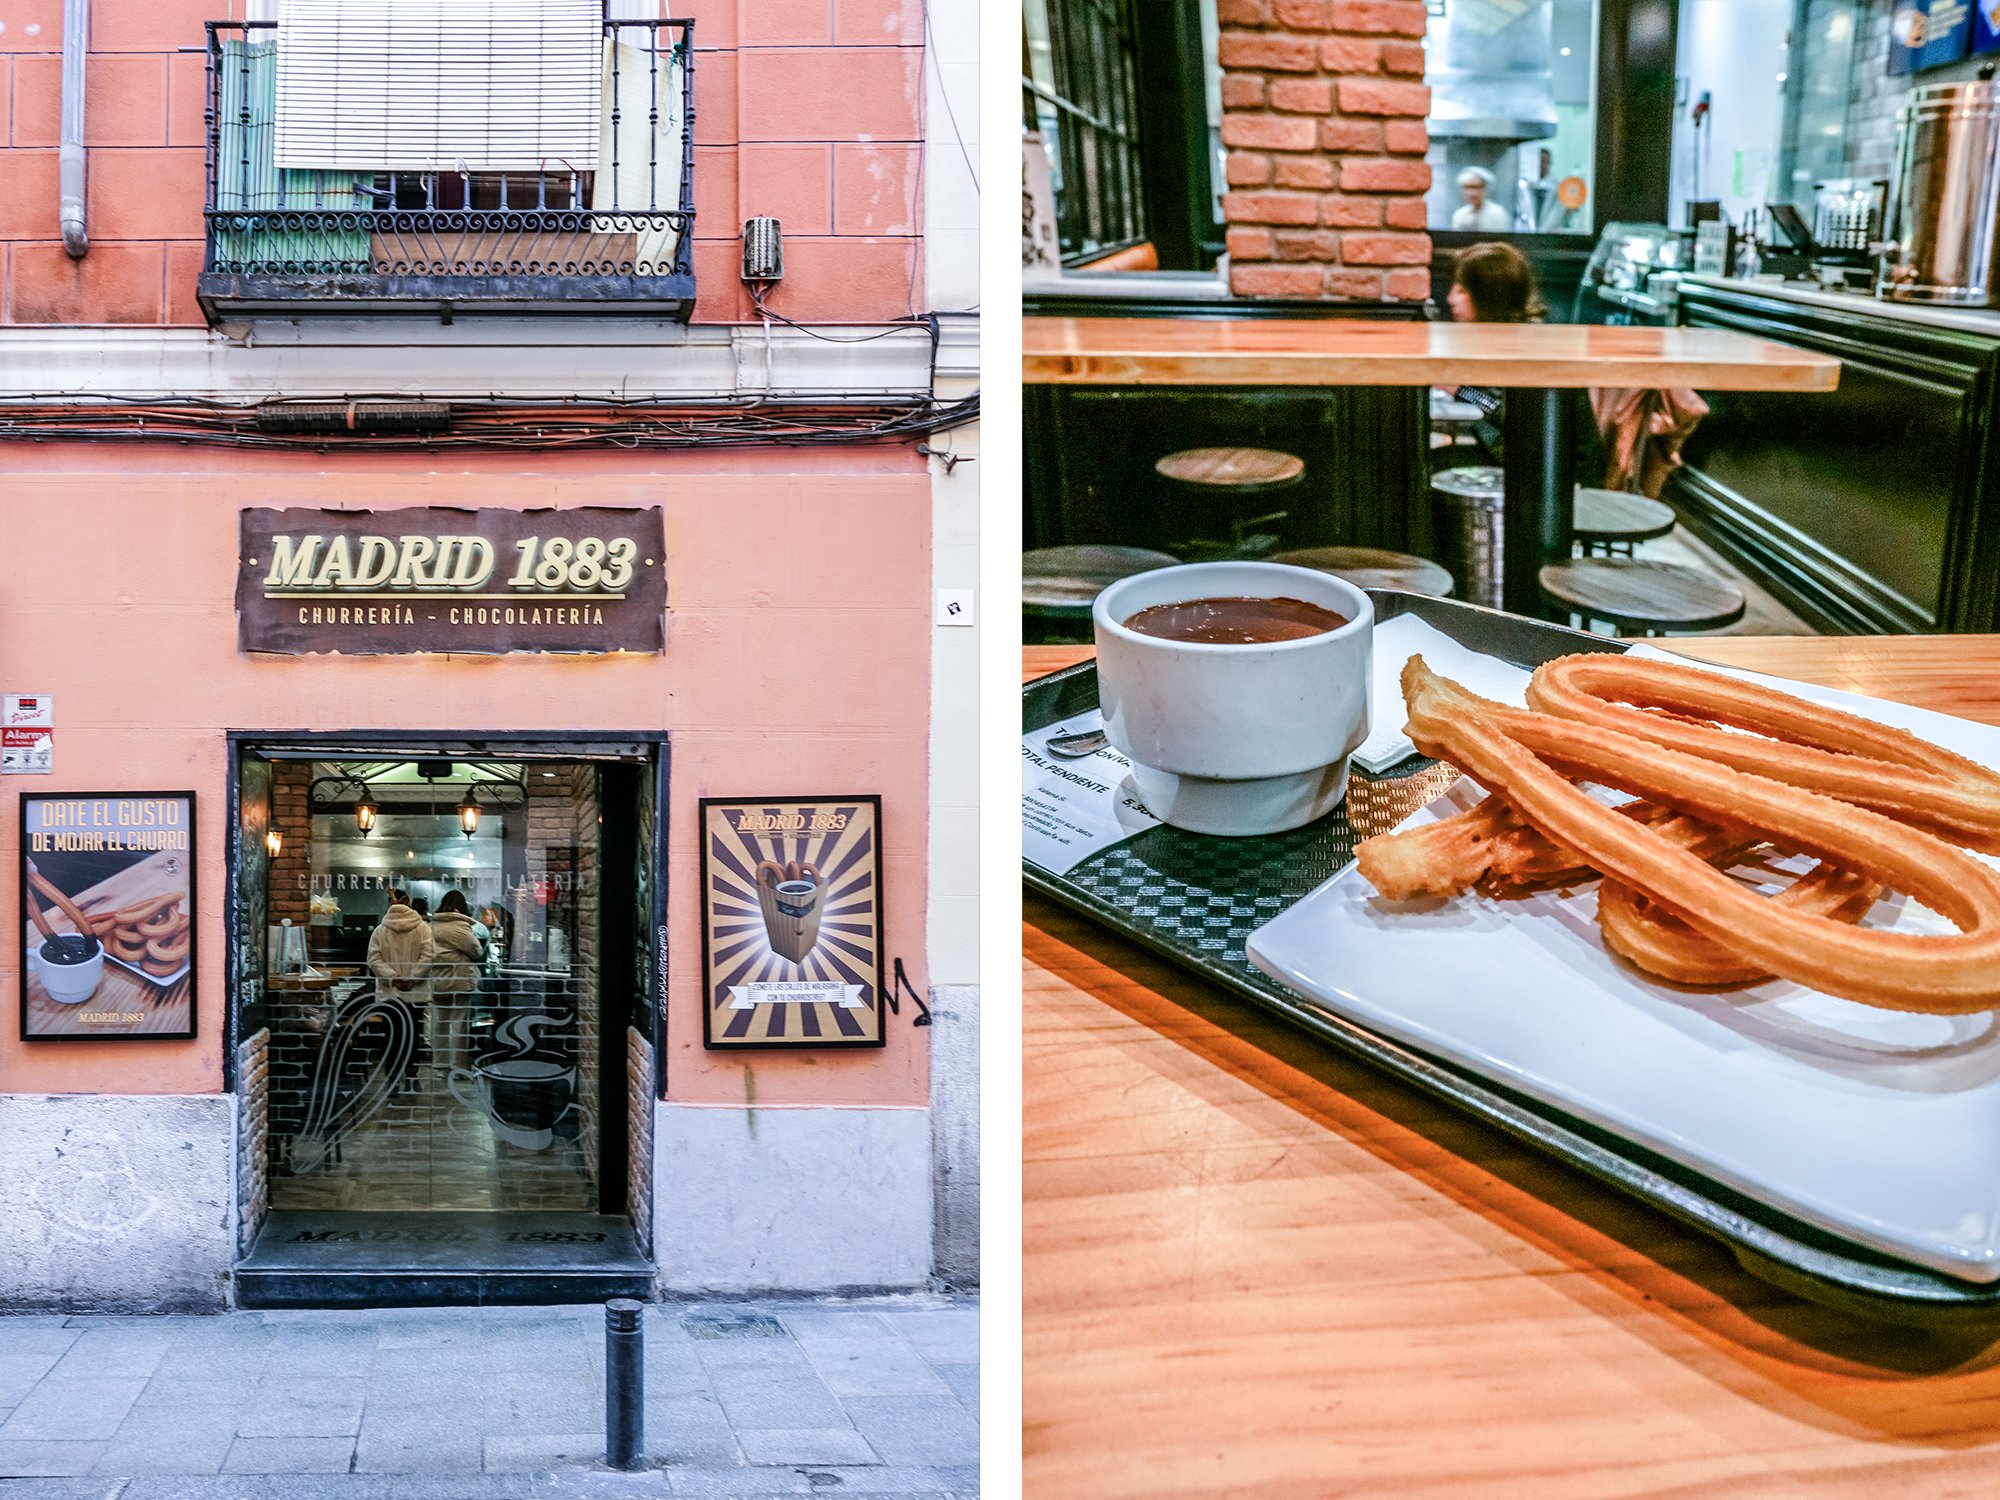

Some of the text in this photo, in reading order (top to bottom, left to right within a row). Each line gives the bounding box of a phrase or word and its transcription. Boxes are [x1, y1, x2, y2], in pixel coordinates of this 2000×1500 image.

[263, 535, 637, 588] MADRID 1883
[299, 604, 415, 625] CHURRERÍA
[450, 605, 604, 626] CHOCOLATERÍA
[1045, 765, 1110, 794] PENDIENTE
[42, 800, 179, 827] DATE EL GUSTO
[737, 813, 847, 831] MADRID 1883
[32, 830, 188, 852] DE MOJAR EL CHURRO
[298, 870, 406, 890] CHURRERÍA
[78, 1012, 145, 1023] MADRID 1883
[501, 1230, 607, 1243] 1883
